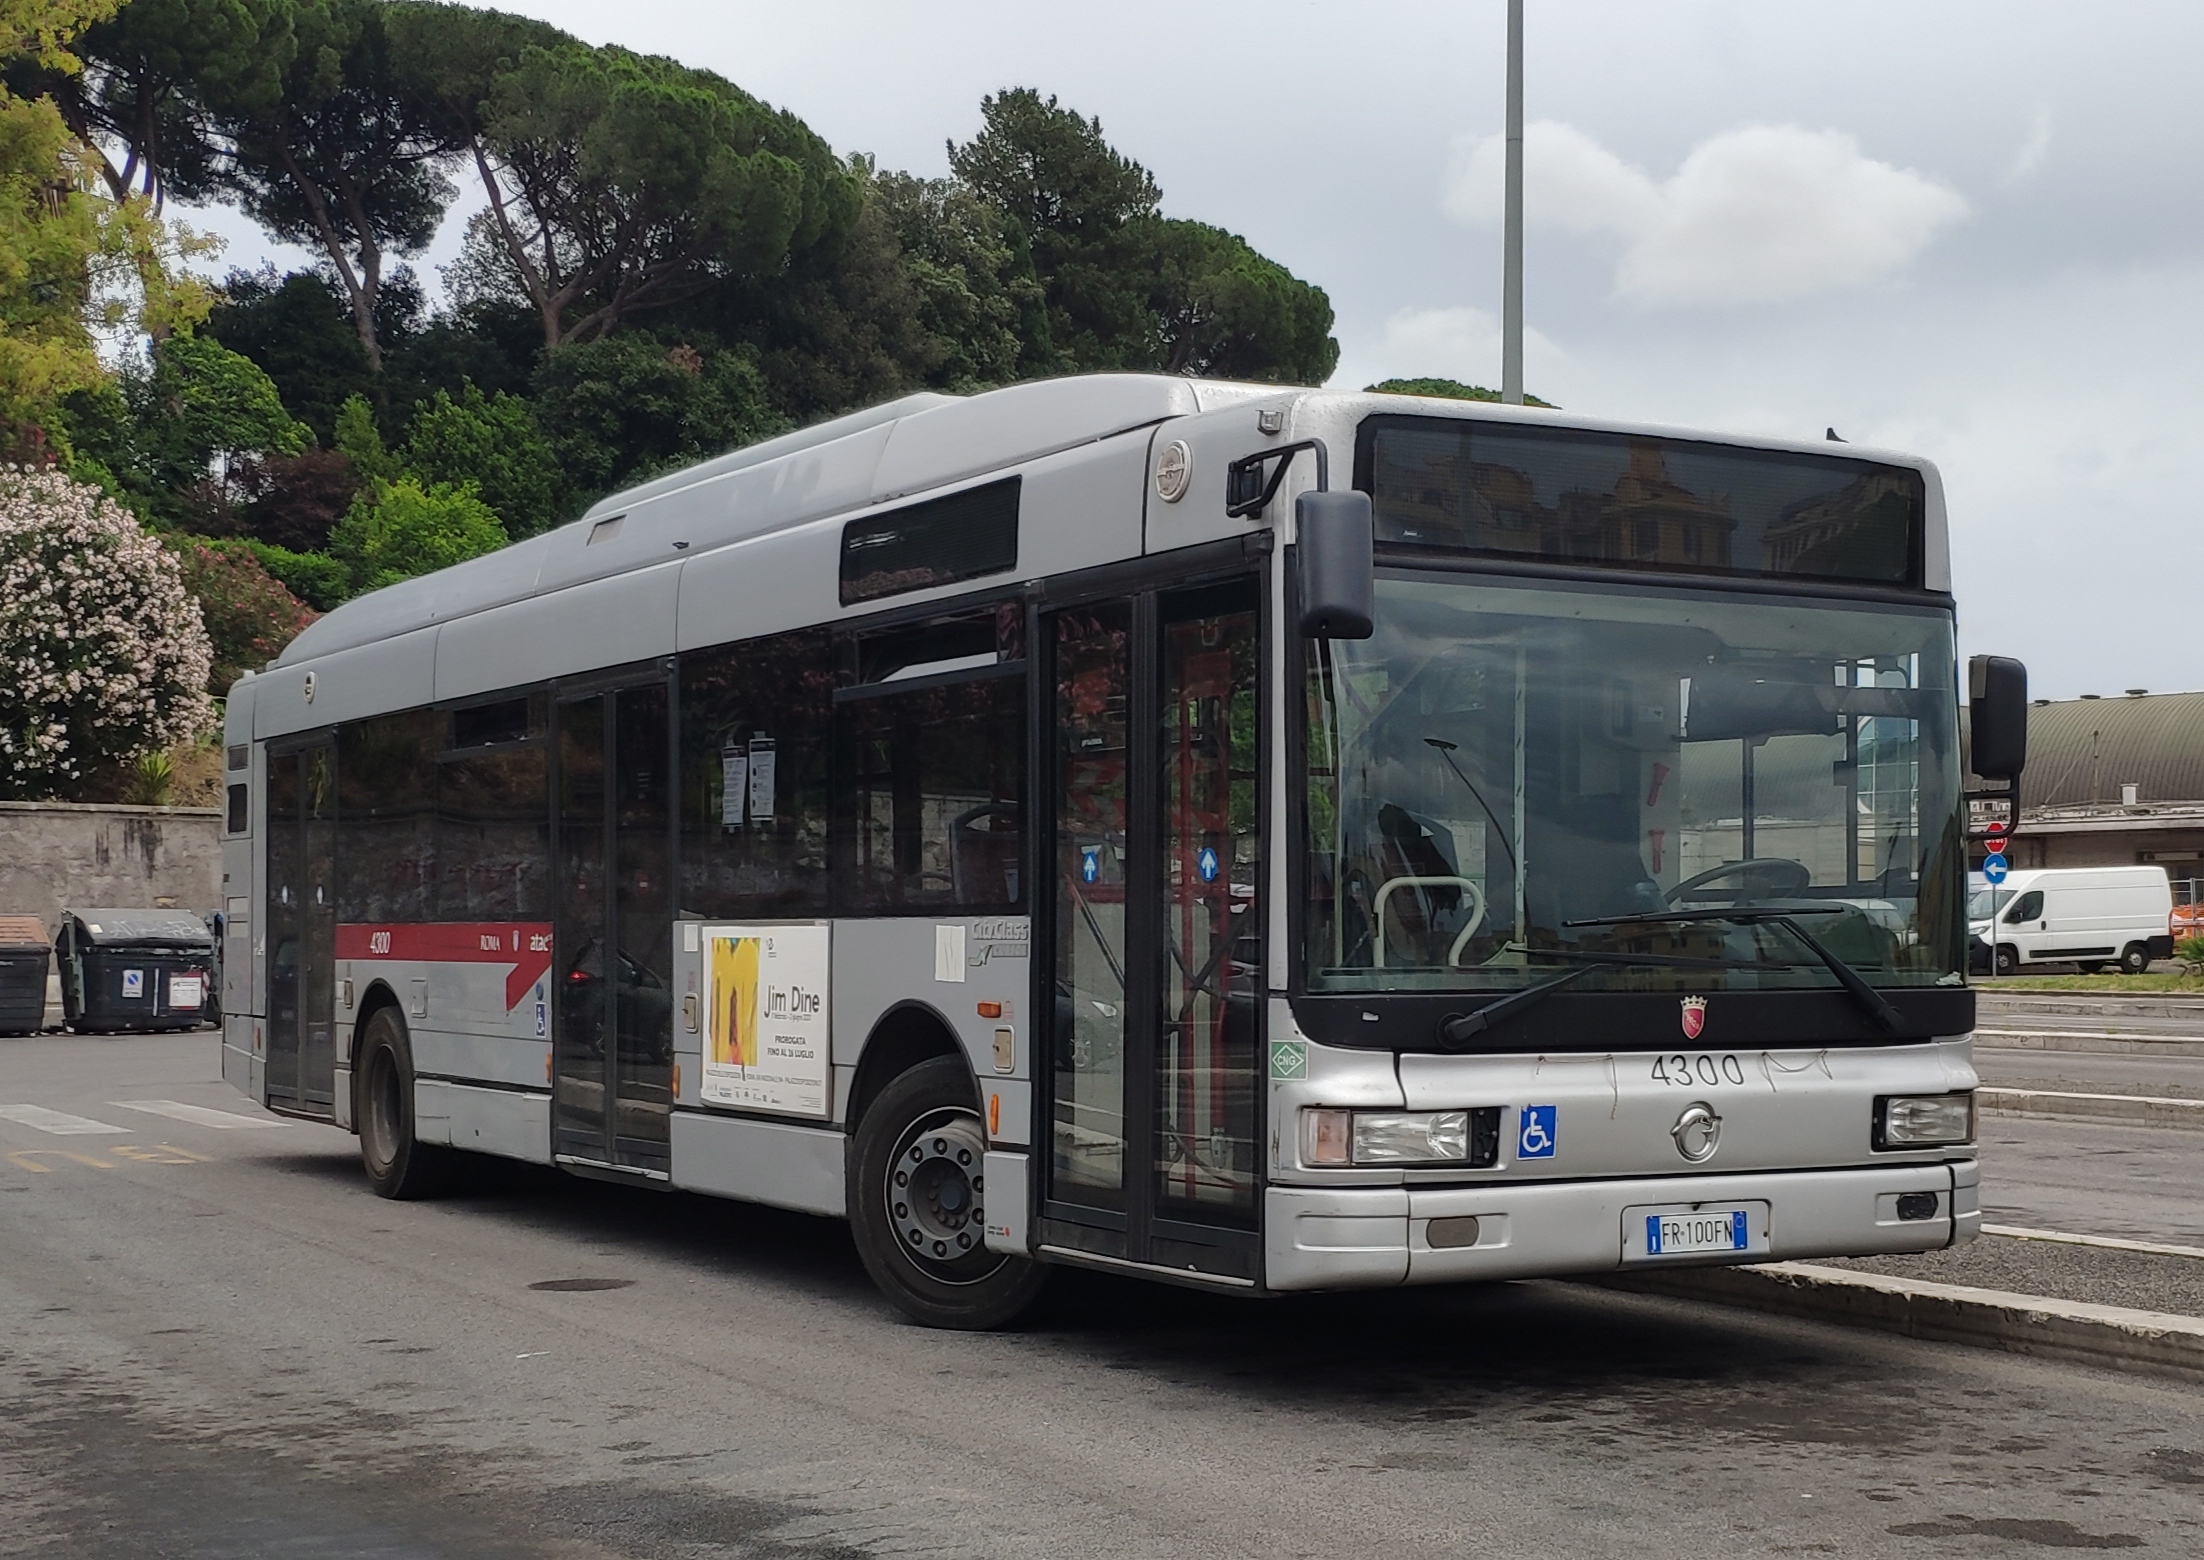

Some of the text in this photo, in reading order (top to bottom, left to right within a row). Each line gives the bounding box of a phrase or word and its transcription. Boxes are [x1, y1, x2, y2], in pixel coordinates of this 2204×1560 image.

[370, 931, 391, 954] 4300
[480, 933, 549, 952] ROMA atac
[763, 985, 820, 1018] Jim Dine
[1277, 1055, 1296, 1066] CNG
[1651, 1053, 1744, 1087] 4300
